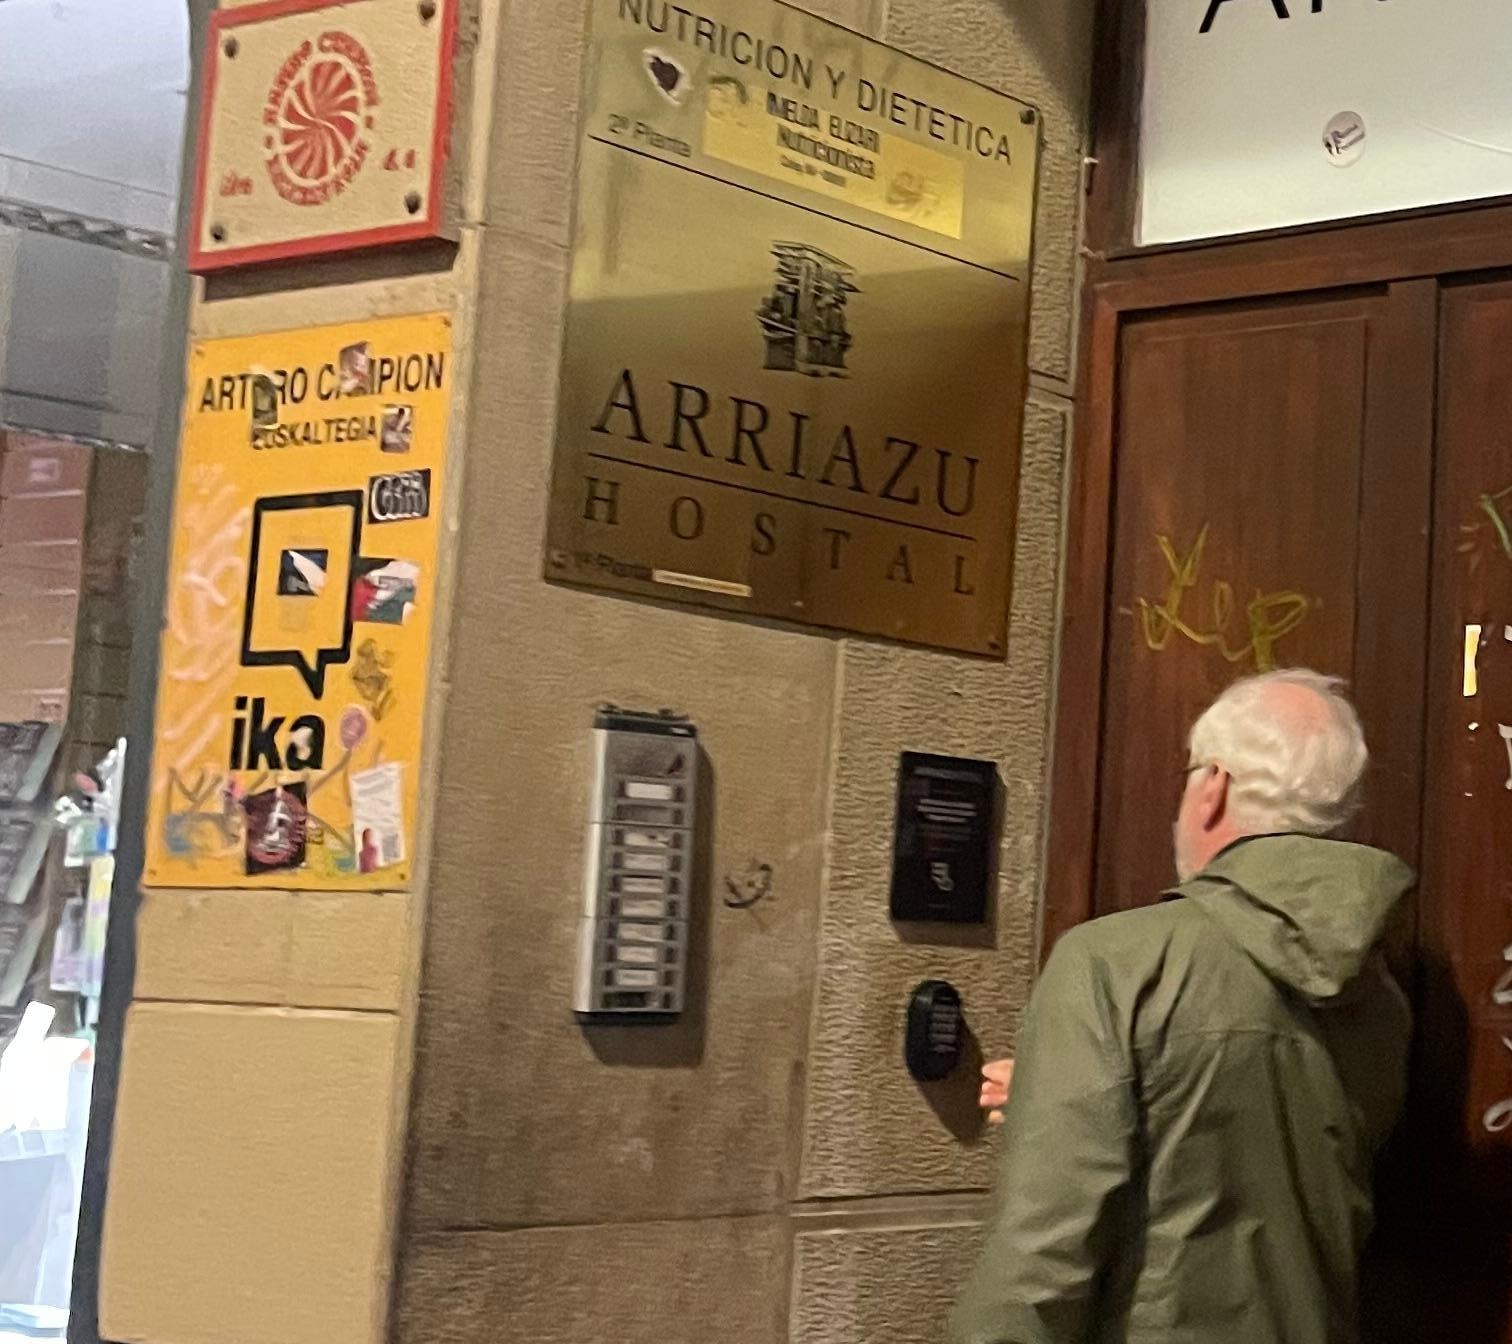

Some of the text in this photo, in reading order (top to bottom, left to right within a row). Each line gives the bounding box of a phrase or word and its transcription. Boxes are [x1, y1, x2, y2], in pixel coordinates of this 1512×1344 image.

[825, 63, 846, 100] Y
[857, 78, 1012, 166] DIETETICA
[199, 351, 445, 413] ARTRO CPION
[590, 367, 980, 518] ARRIAZU
[583, 476, 975, 596] HOSTAL
[229, 695, 326, 771] ika
